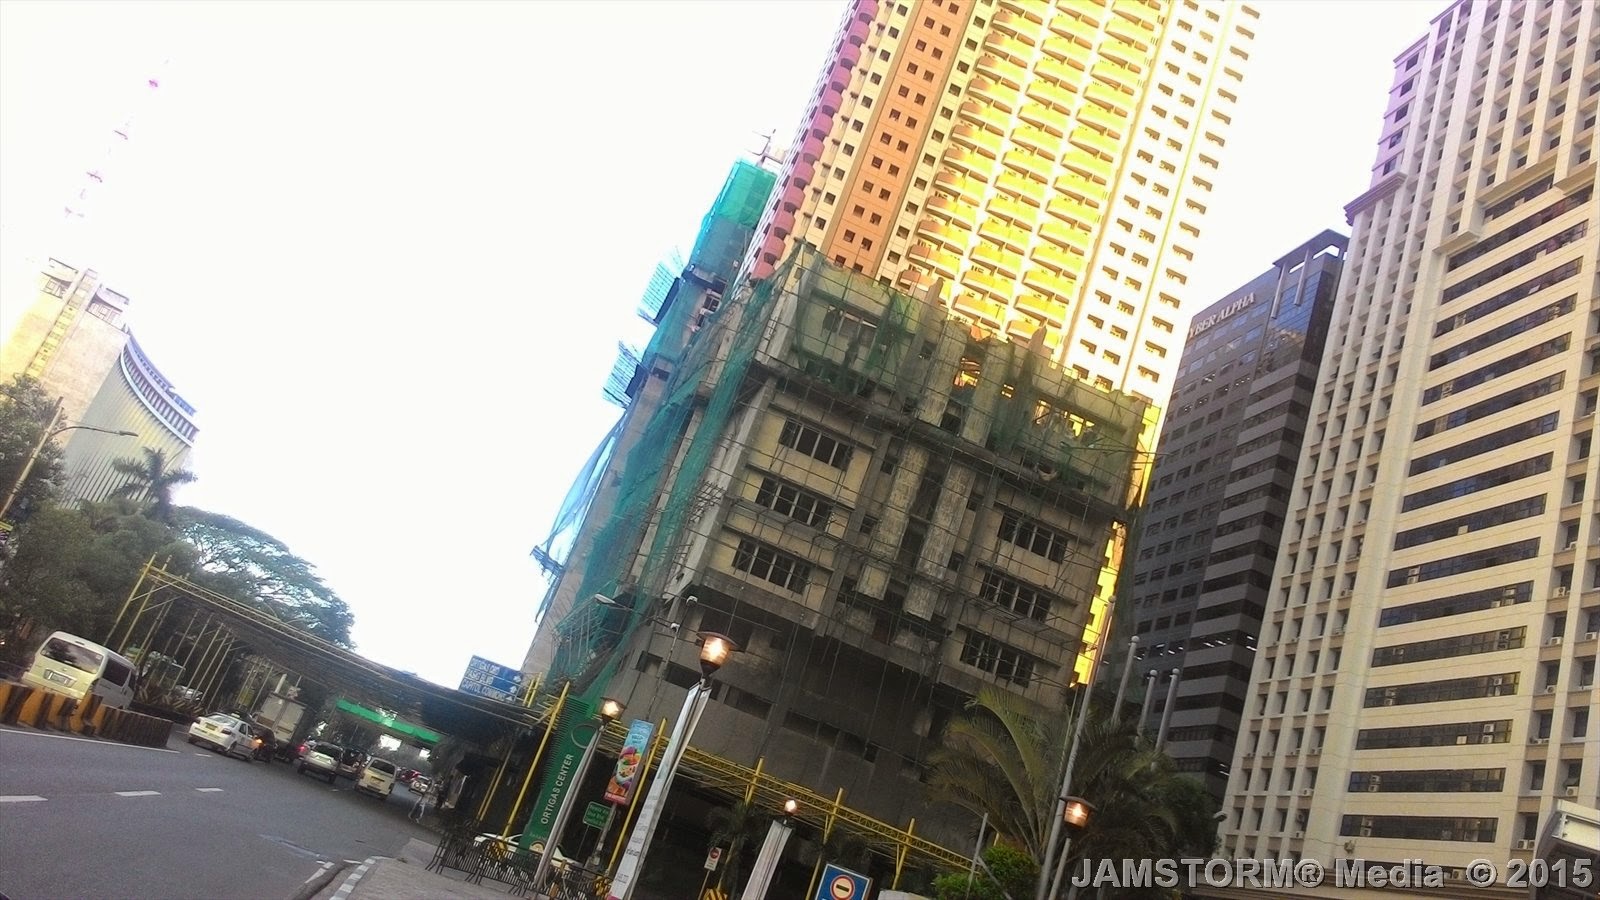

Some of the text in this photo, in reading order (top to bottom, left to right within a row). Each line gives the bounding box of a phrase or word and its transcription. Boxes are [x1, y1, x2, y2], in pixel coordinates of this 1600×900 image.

[1217, 293, 1255, 322] ALPHA
[461, 679, 481, 693] CAPITOL
[540, 754, 575, 825] ORTIGAS CENTER
